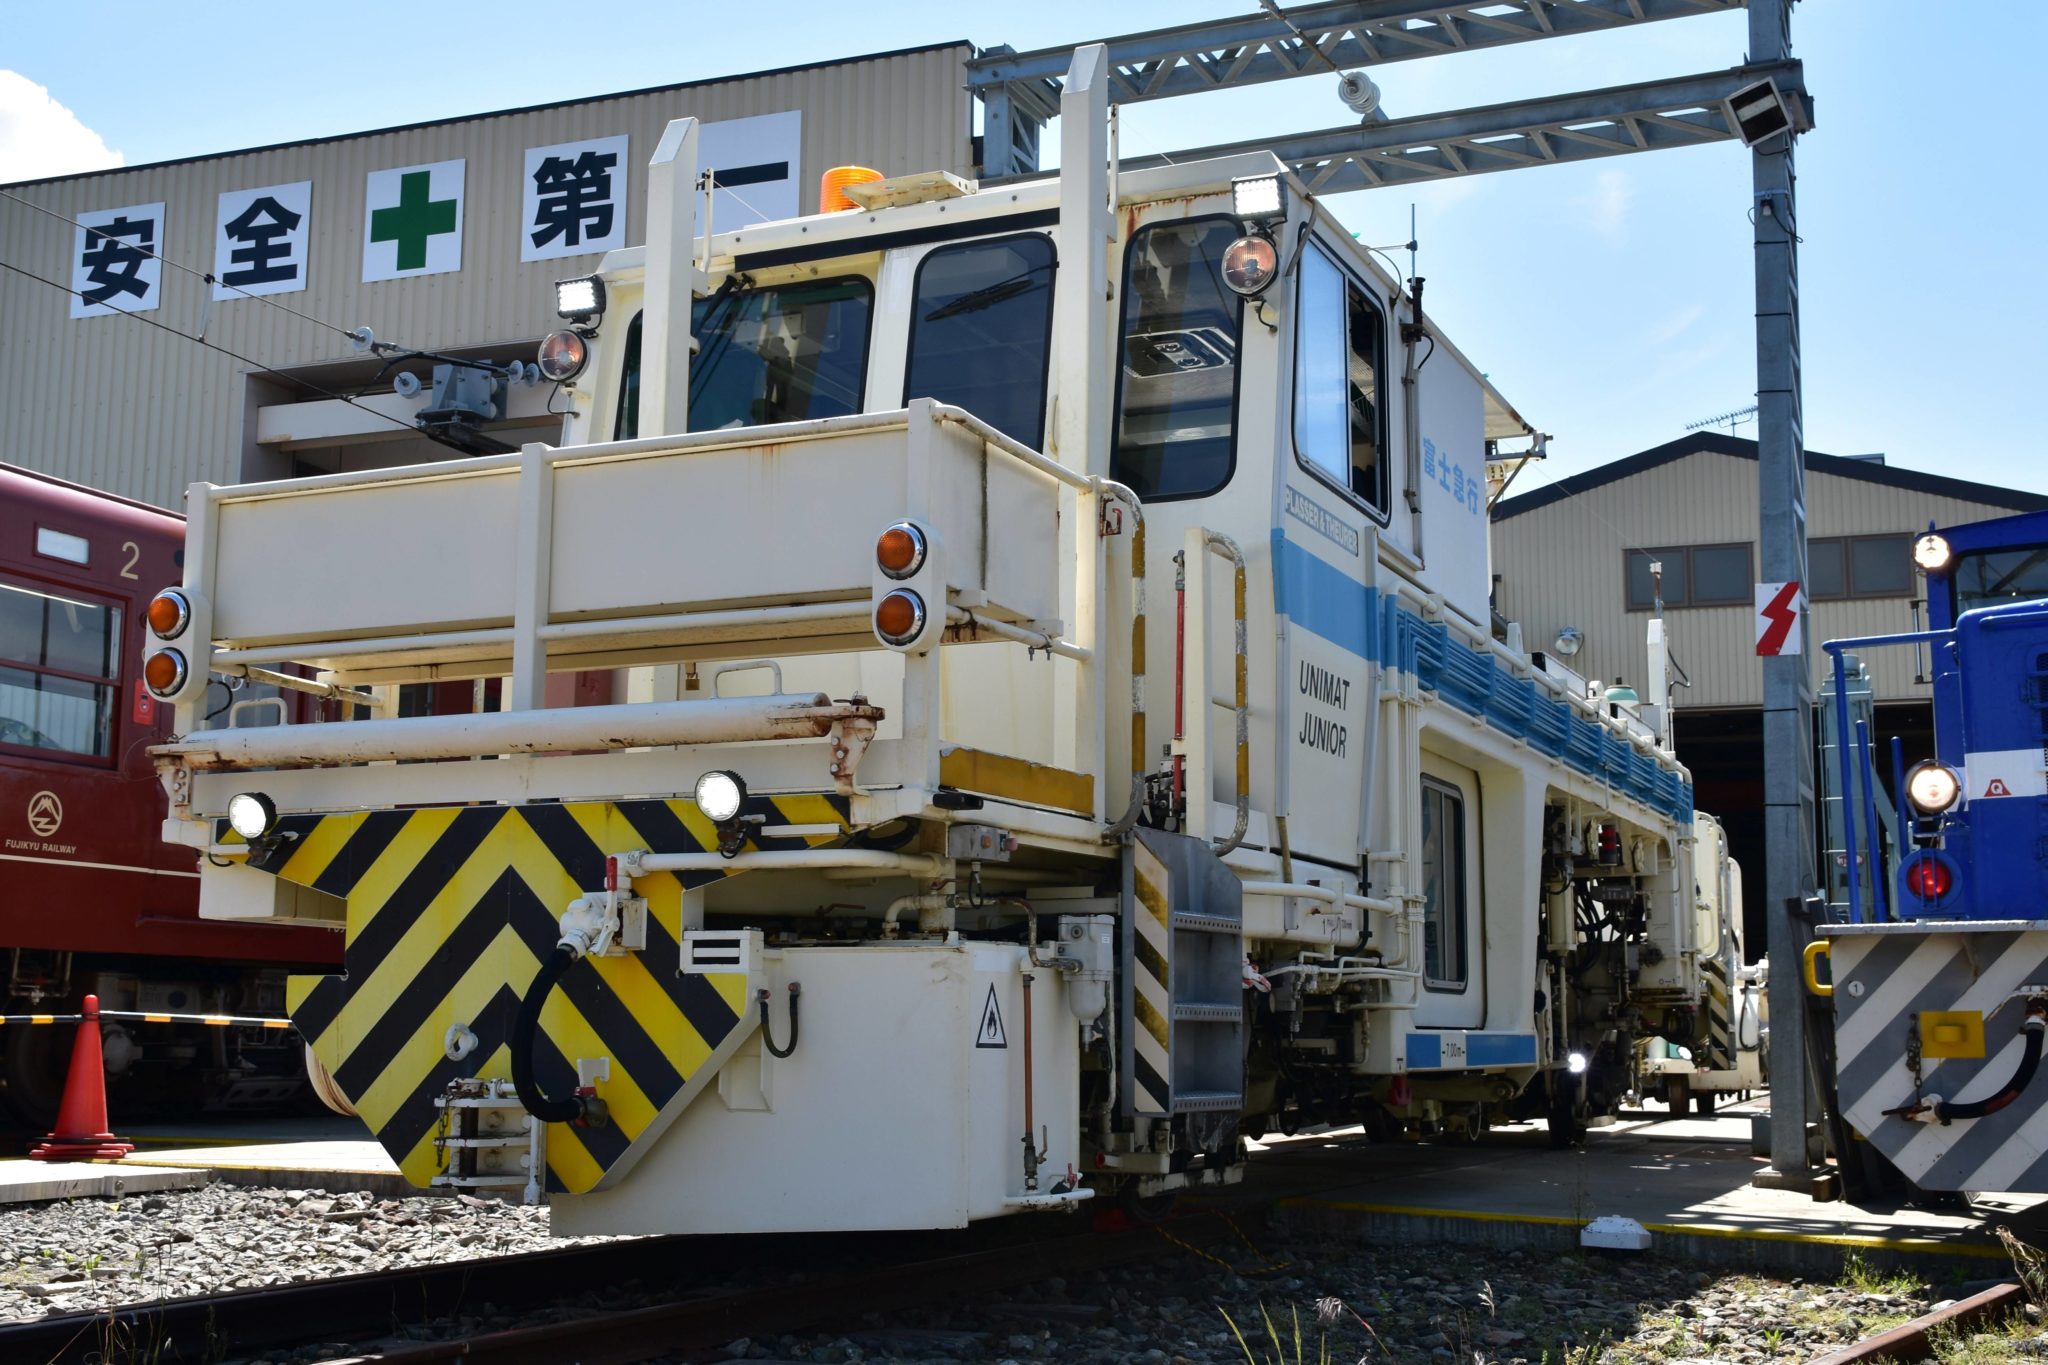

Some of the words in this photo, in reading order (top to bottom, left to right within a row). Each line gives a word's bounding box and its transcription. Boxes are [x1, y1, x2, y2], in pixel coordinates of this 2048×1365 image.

[81, 197, 302, 307] 安全
[531, 152, 789, 249] 第一
[1423, 437, 1478, 515] 富士急行
[1286, 489, 1320, 530] PLASSER
[1325, 513, 1357, 552] THEURER
[120, 541, 140, 580] 2
[1300, 660, 1350, 711] UNIMAT
[1299, 712, 1347, 759] JUNIOR
[5, 839, 40, 851] FUJIKYU
[42, 843, 76, 854] RAILWAY
